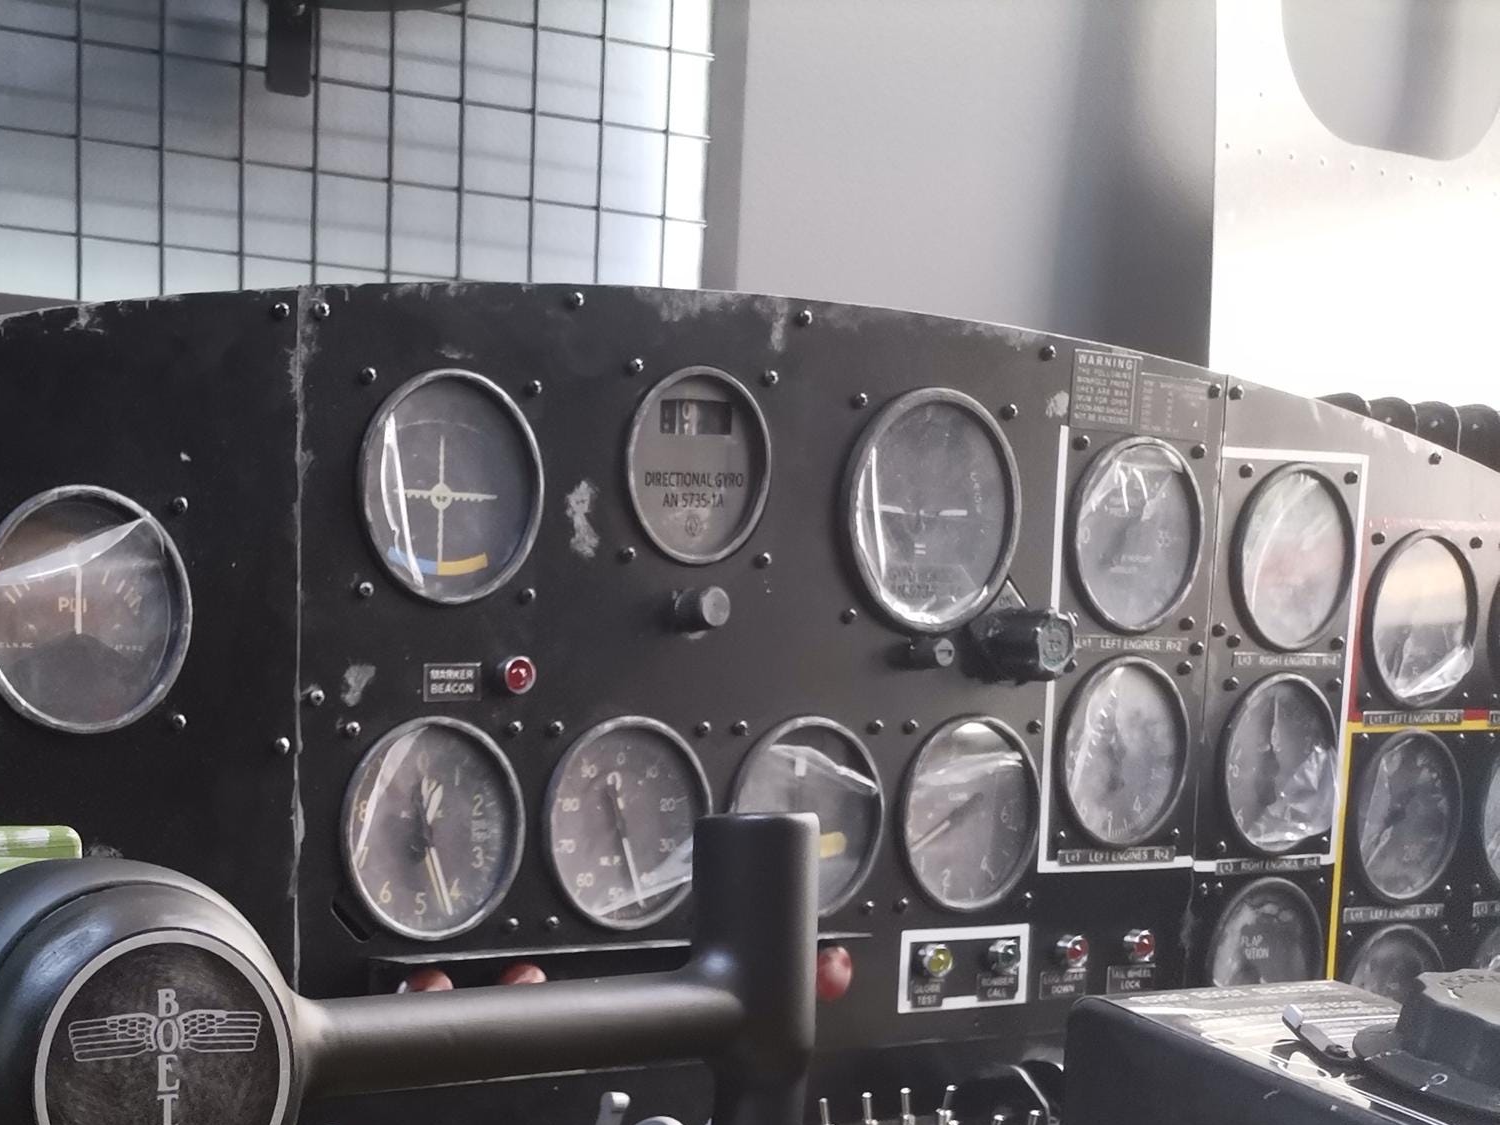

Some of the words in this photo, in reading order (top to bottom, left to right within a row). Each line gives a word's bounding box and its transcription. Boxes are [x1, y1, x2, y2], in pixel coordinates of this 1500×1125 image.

[1078, 354, 1133, 370] WARNING
[645, 472, 712, 486] DIRECTIONAL
[715, 473, 744, 486] GYRO
[663, 494, 678, 507] AN
[1100, 639, 1121, 648] LEFT
[1124, 640, 1160, 650] ENGINES
[430, 669, 474, 680] MARKER
[430, 683, 474, 694] BEACON
[472, 794, 484, 816] 2
[472, 846, 484, 868] 3
[379, 880, 392, 902] 6
[414, 892, 426, 915] 5
[1052, 984, 1075, 994] DOWN
[1121, 980, 1140, 990] LOCK
